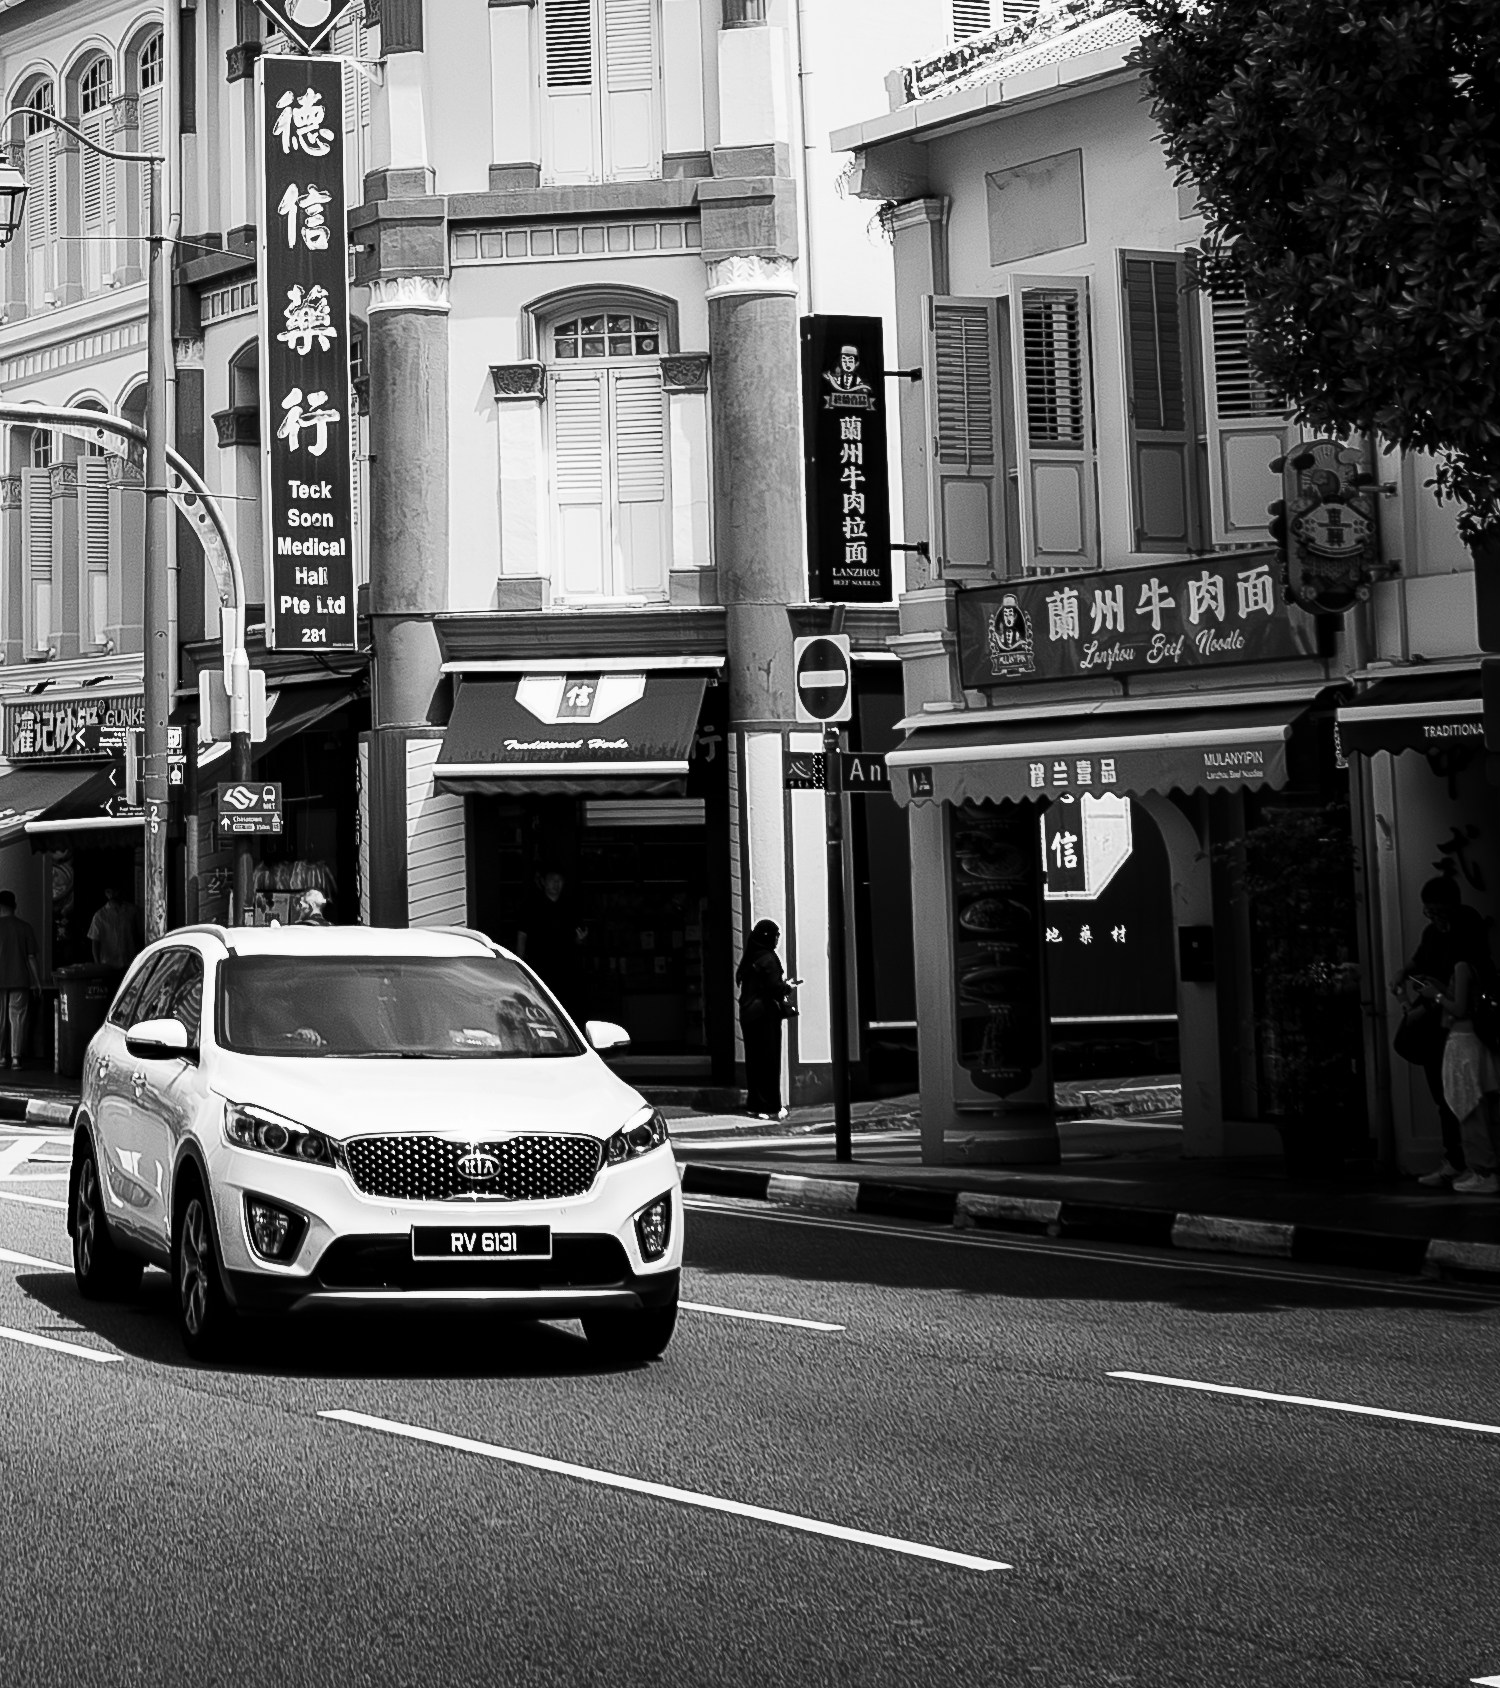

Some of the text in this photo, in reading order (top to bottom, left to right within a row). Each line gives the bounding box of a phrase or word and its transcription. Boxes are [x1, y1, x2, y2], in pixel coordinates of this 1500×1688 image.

[288, 480, 332, 499] Teck
[288, 508, 334, 527] Soon
[278, 537, 346, 556] Medical
[295, 566, 329, 585] Hall
[832, 567, 880, 577] LANZHOU
[280, 595, 346, 614] Pte Ltd
[1046, 565, 1274, 641] 蘭州牛肉面
[301, 628, 326, 642] 281
[1080, 640, 1136, 671] Lanzhou
[1146, 632, 1184, 663] Beef
[566, 685, 594, 706] 信
[106, 708, 145, 726] GUNKE
[1423, 723, 1485, 738] TRADITIONA
[850, 758, 890, 781] An
[1051, 831, 1078, 868] 信
[464, 1159, 494, 1174] KIA
[451, 1232, 517, 1252] RV 6131
